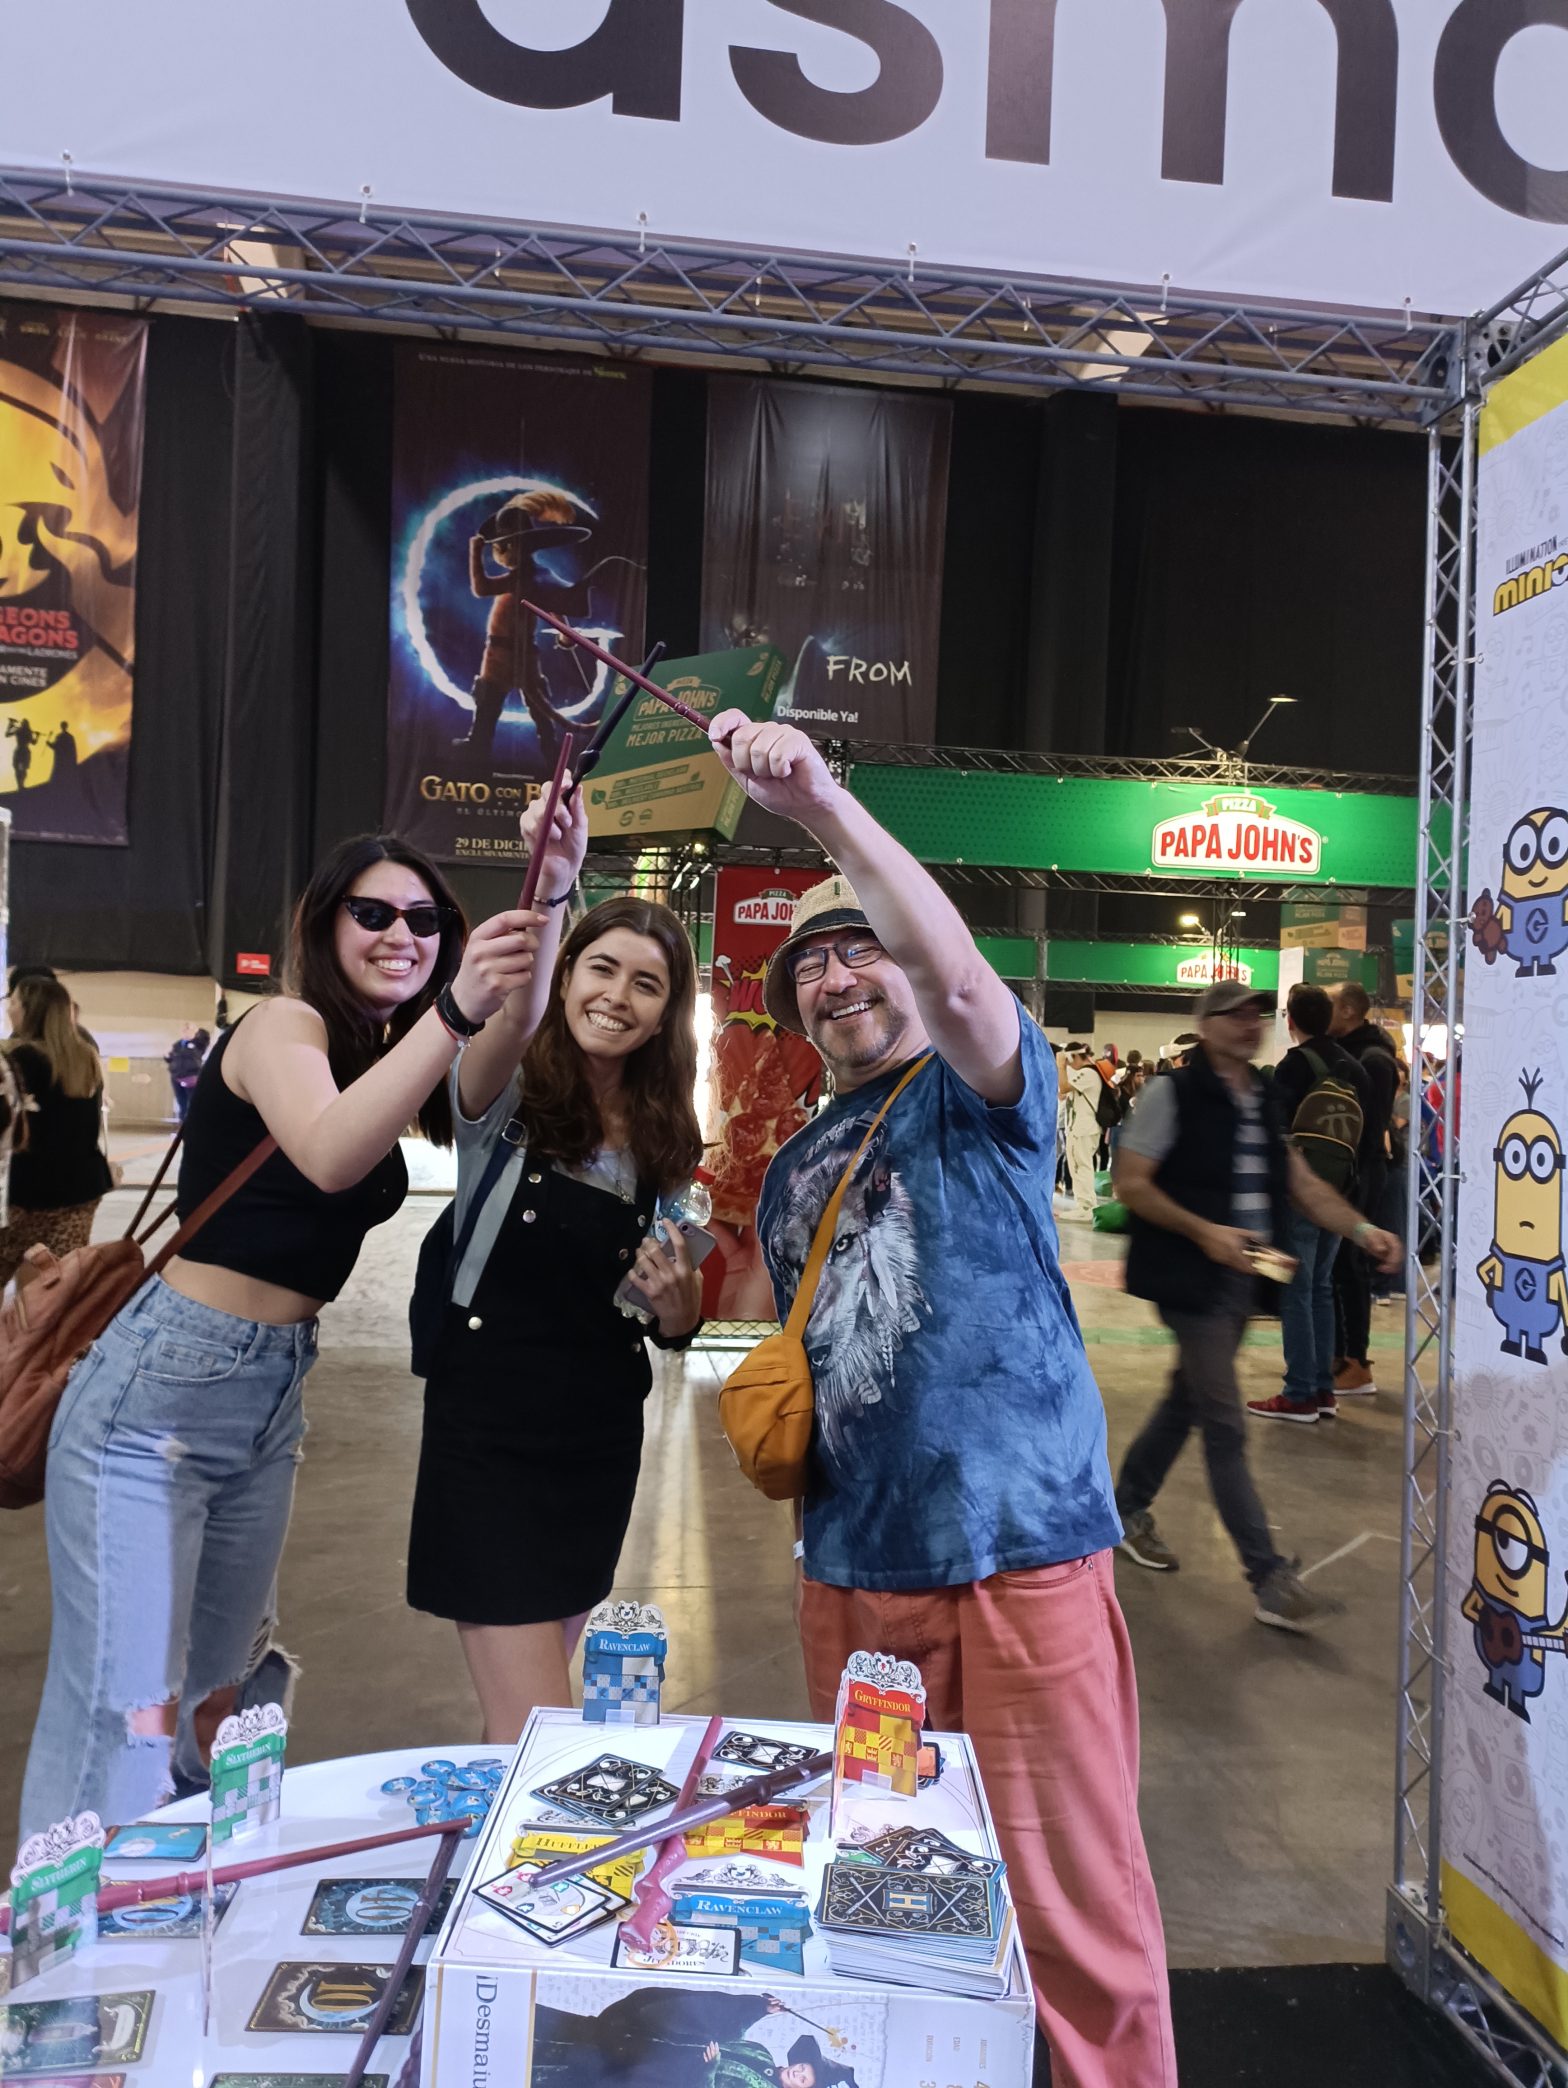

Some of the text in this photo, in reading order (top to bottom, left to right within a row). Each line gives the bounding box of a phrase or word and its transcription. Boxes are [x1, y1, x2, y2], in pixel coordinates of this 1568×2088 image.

[0, 606, 71, 629] EONS
[827, 655, 912, 686] FROM
[777, 706, 859, 723] Disponible Ya!
[626, 731, 665, 747] MEJOR
[420, 775, 490, 803] GATO
[495, 787, 521, 799] CON
[1222, 798, 1257, 812] PIZZA
[455, 837, 529, 852] 29 DE DICI
[1161, 824, 1313, 864] PAPA JOHN'S
[769, 890, 787, 898] PIZZA
[738, 902, 794, 921] PAPA JO
[1181, 964, 1208, 979] PAPA
[599, 1638, 650, 1651] RAVENCLAW
[854, 1689, 911, 1712] GRYFFINDOR
[696, 1899, 783, 1915] RAVENCLAW
[311, 1980, 377, 2011] 10
